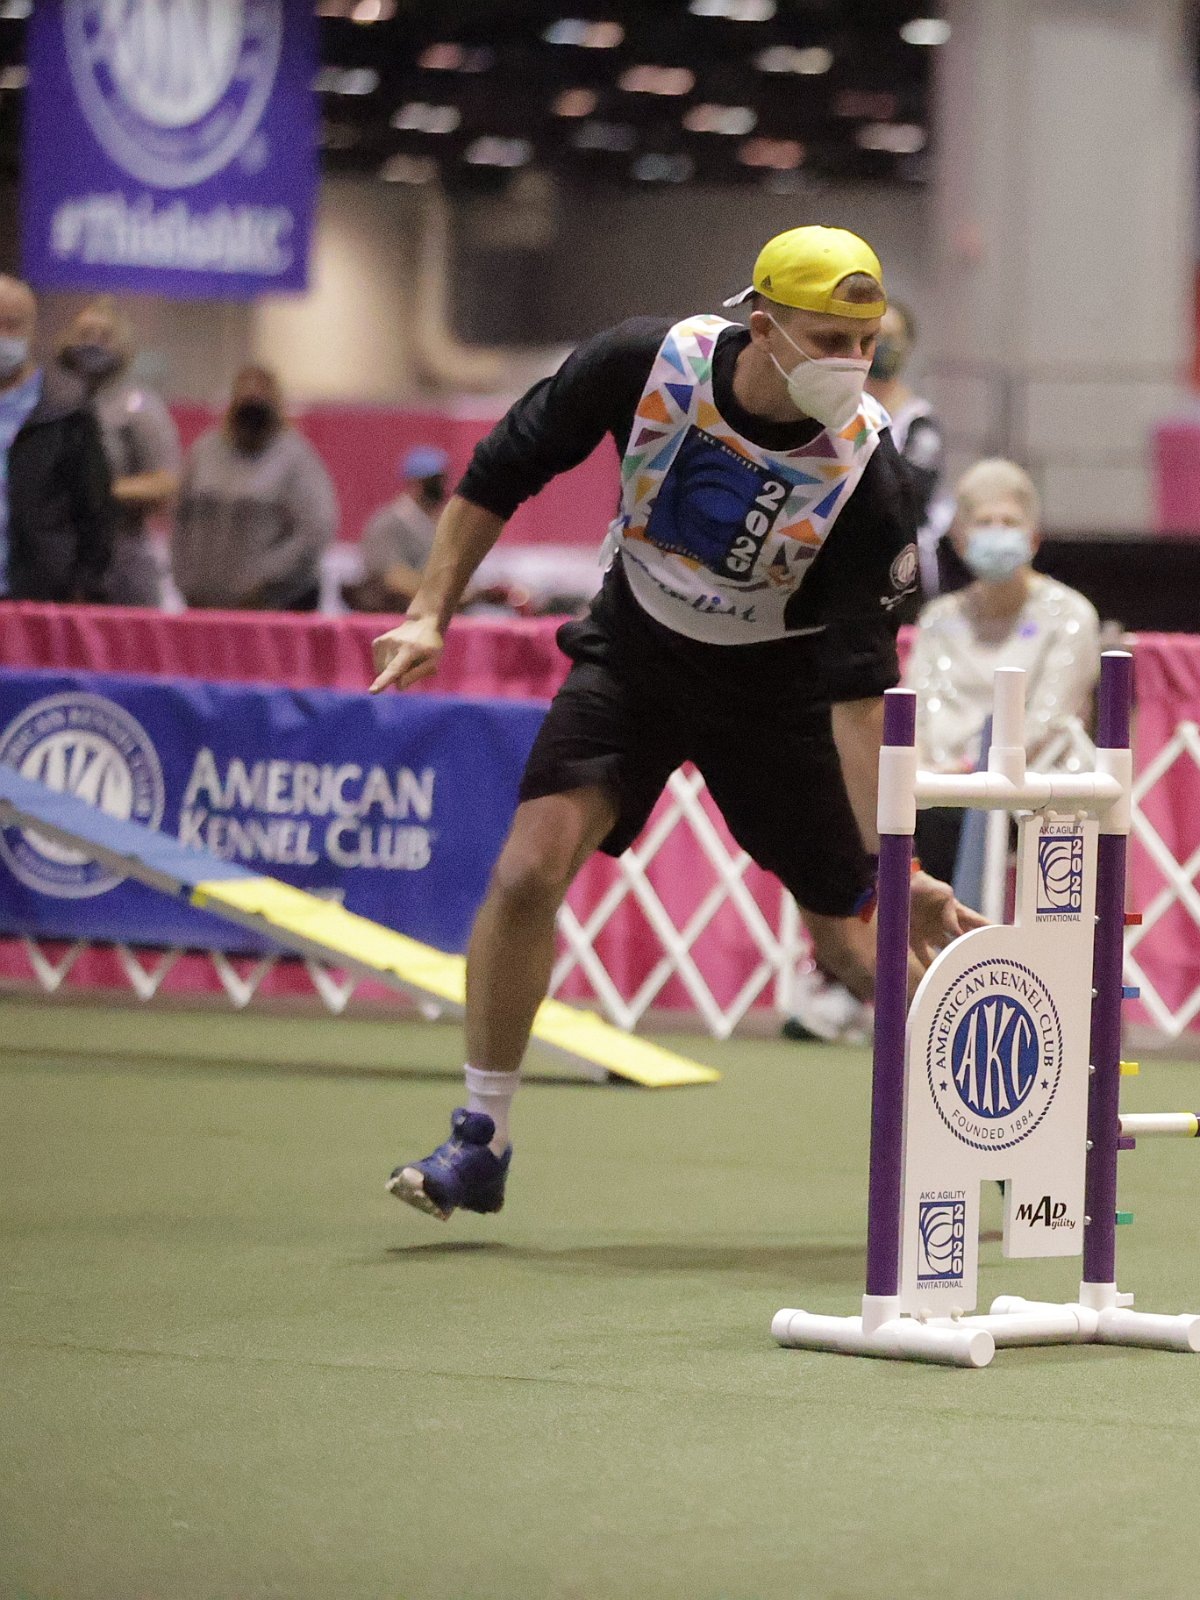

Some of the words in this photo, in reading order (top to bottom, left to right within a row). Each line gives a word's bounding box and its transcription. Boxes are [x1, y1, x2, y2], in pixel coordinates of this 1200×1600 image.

[726, 481, 786, 573] 2020
[184, 746, 435, 820] AMERICAN
[178, 808, 318, 867] KENNEL
[325, 814, 434, 871] CLUB
[1039, 825, 1055, 835] AKC
[1056, 825, 1084, 835] AGILITY
[1070, 838, 1083, 909] 2020
[1035, 914, 1081, 923] INVITATIONAL
[935, 974, 986, 1070] AMERICAN
[989, 970, 1044, 1013] KENNEL
[1039, 1013, 1054, 1067] CLUB
[955, 1000, 1033, 1116] AKC
[951, 1108, 1005, 1140] FOUNDED
[1010, 1109, 1034, 1133] 1884
[919, 1191, 935, 1200] AKC
[937, 1190, 966, 1200] AGILITY
[953, 1203, 964, 1274] 2020
[916, 1280, 963, 1290] INVITATIONAL
